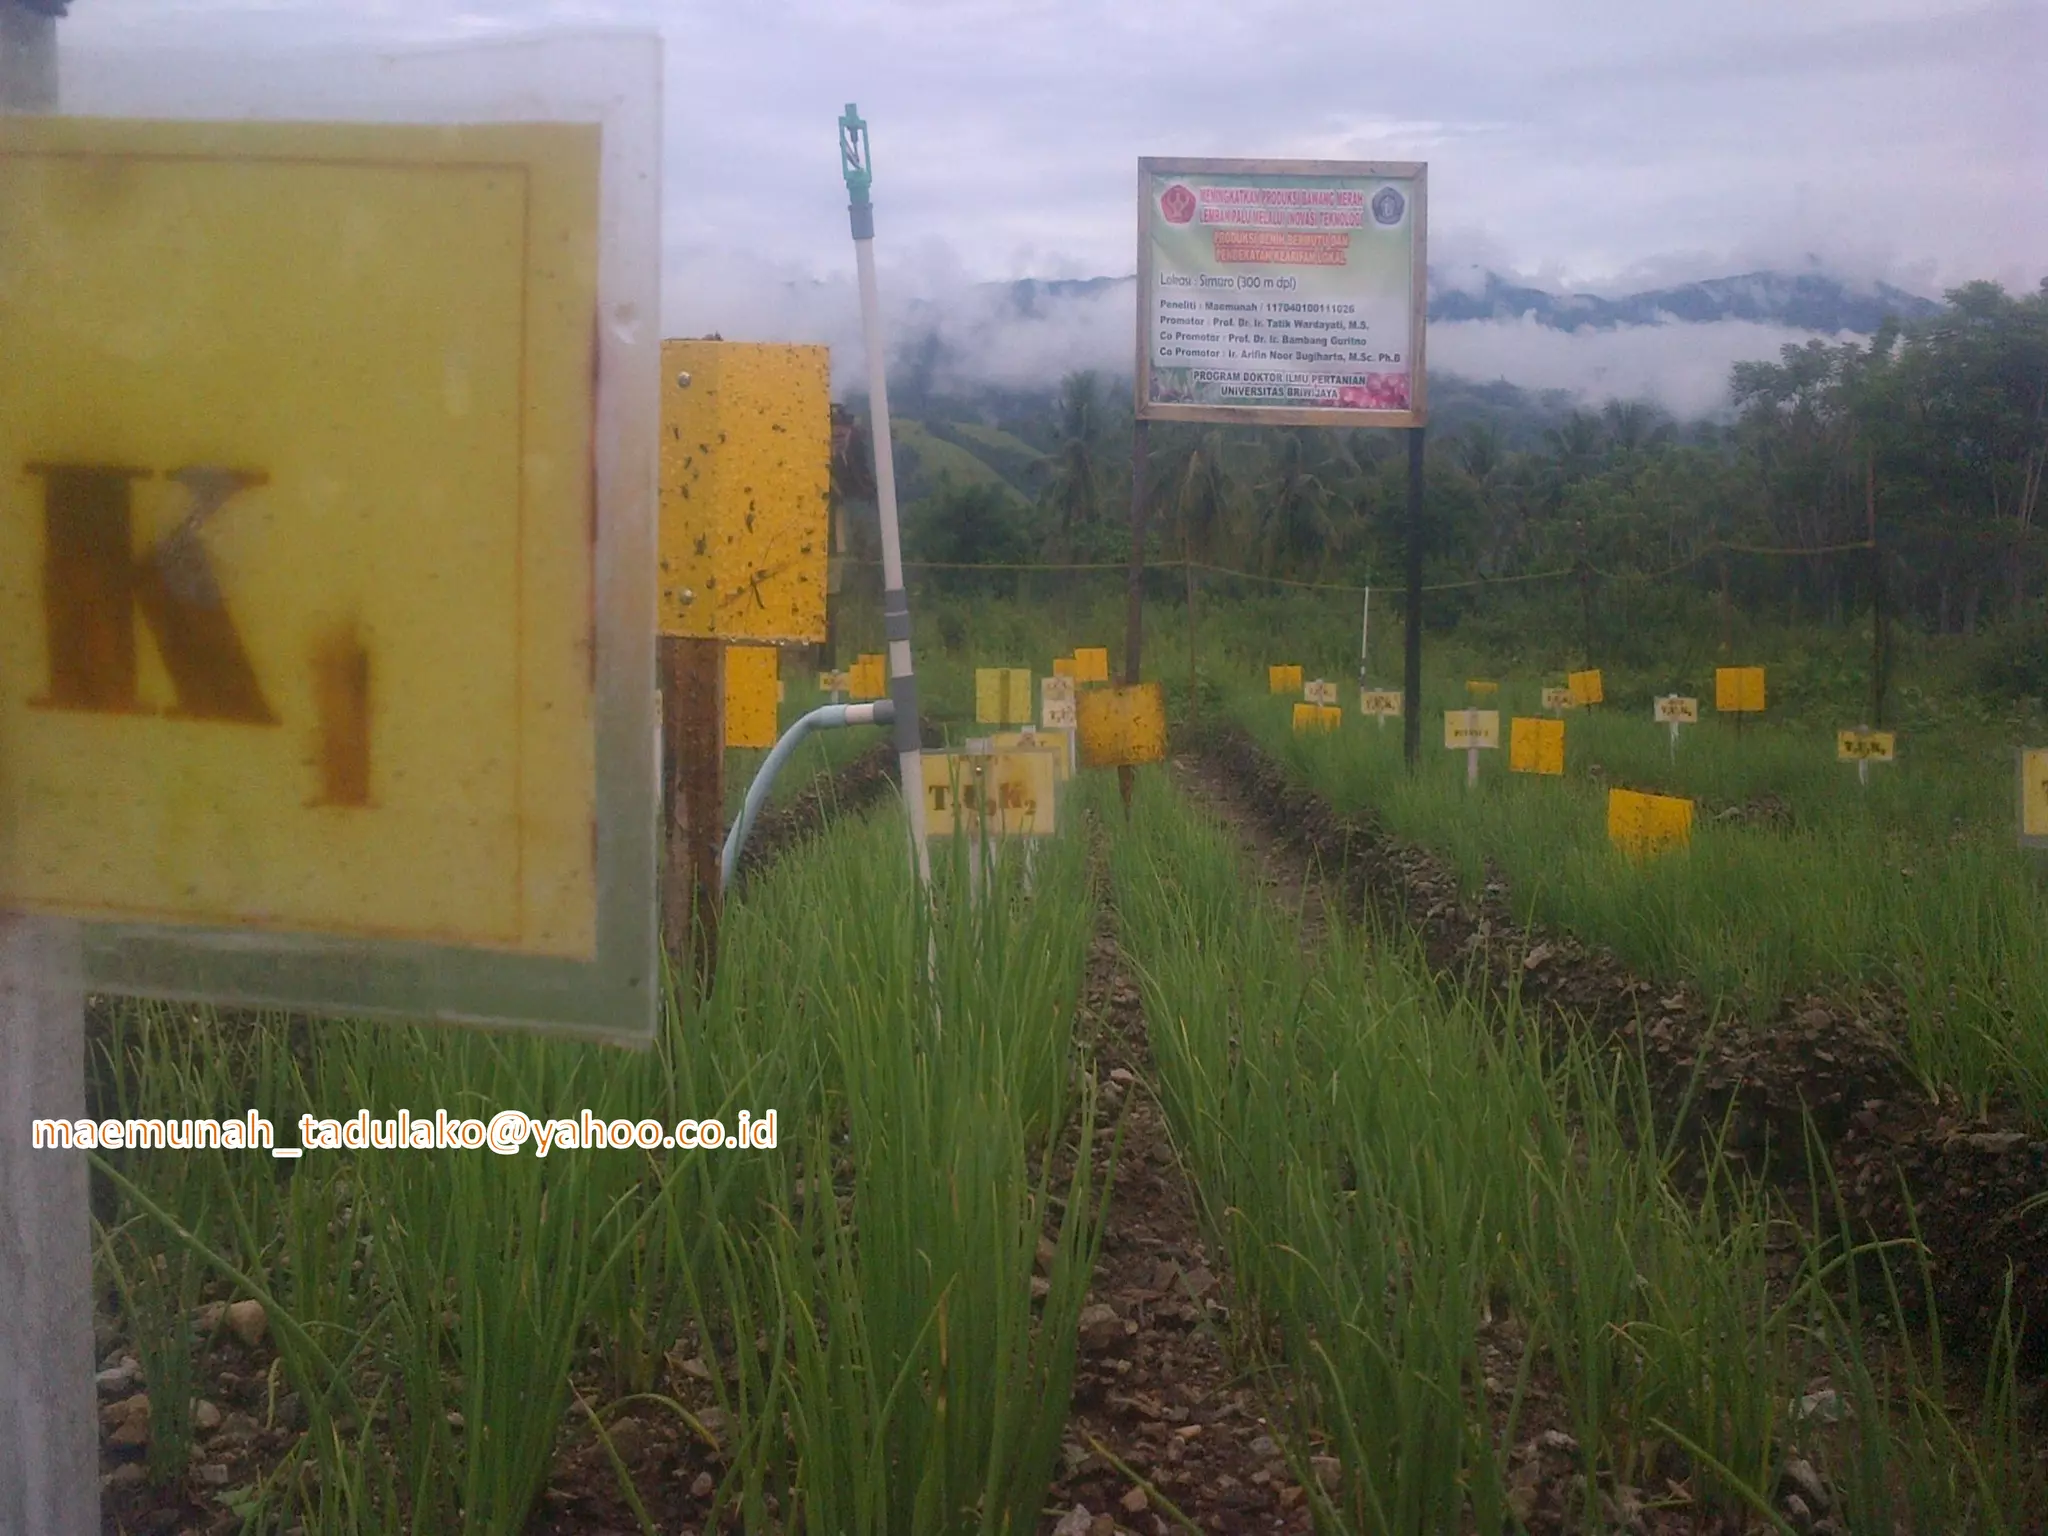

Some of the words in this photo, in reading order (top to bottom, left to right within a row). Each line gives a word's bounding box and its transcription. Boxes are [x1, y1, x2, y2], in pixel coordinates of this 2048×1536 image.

[1237, 275, 1261, 290] (300
[1263, 279, 1274, 288] m
[1276, 276, 1296, 291] dpl)
[1160, 300, 1196, 310] Peneliti
[1205, 302, 1257, 311] Maemunah
[1160, 315, 1204, 326] Promotor
[1266, 319, 1291, 329] Tatik
[1160, 331, 1172, 341] Co
[1175, 332, 1220, 342] Promotor
[1282, 335, 1327, 347] Bambang
[1160, 347, 1172, 356] Co
[1175, 347, 1220, 358] Promotor
[1241, 350, 1267, 360] Arifin
[1269, 351, 1293, 360] Noor
[1193, 371, 1241, 381] PROGRAM
[1243, 372, 1283, 382] DOKTOR
[1285, 373, 1309, 383] ILMU
[1312, 374, 1366, 385] PERTANIAN
[1221, 386, 1284, 397] UNIVERSITAS
